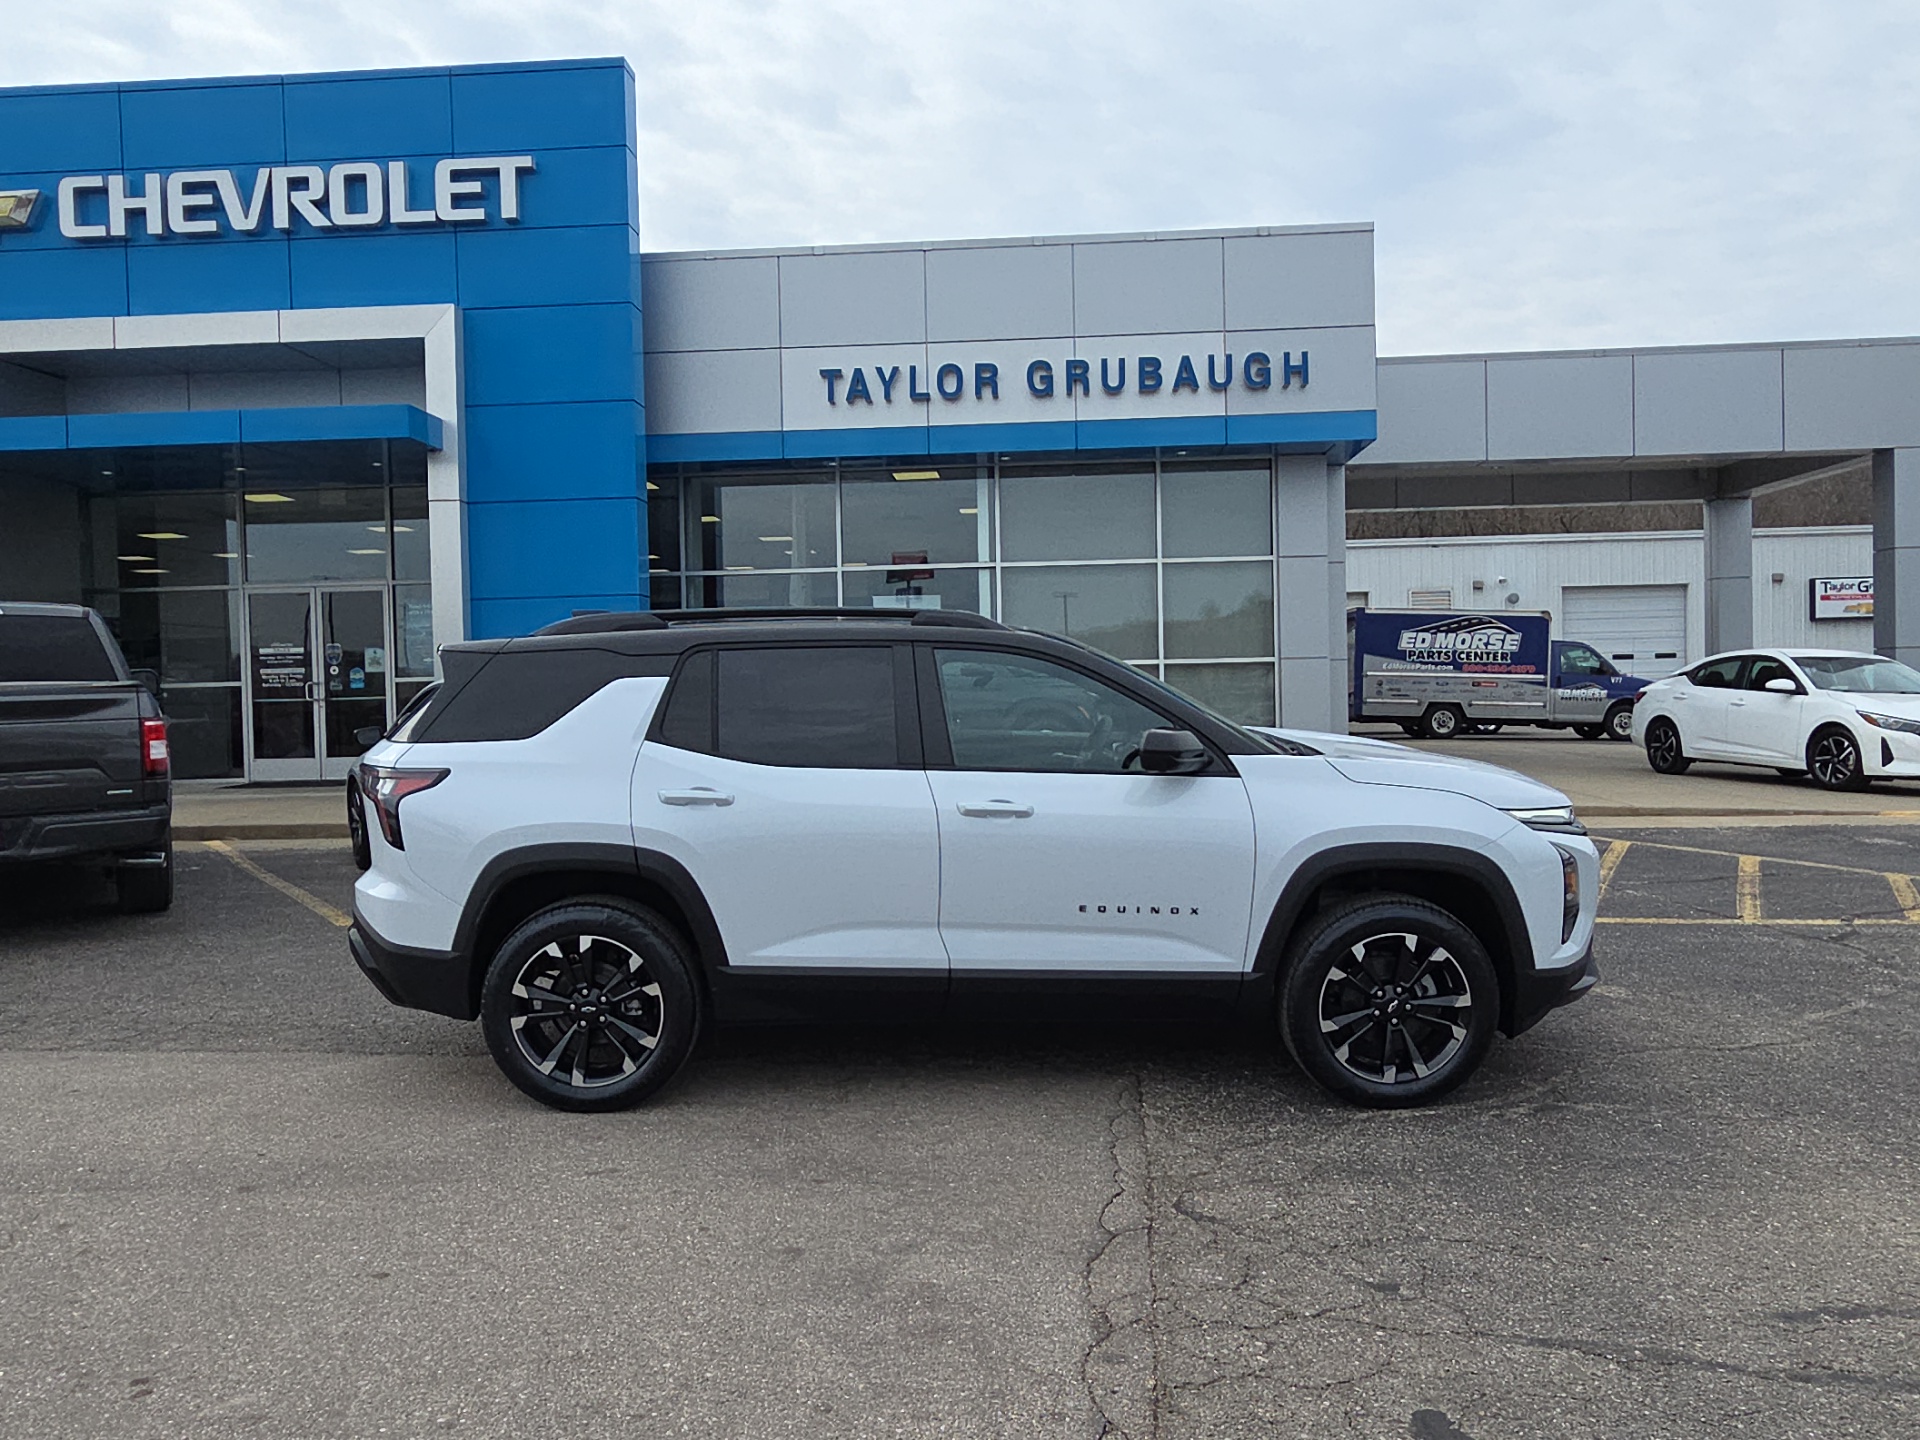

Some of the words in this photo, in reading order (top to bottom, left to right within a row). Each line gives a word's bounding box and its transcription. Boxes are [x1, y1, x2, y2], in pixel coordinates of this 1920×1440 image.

[58, 155, 535, 240] CHEVROLET
[819, 363, 1000, 405] TAYLOR
[1026, 350, 1310, 398] GRUBAUGH
[1820, 581, 1855, 593] Taylor
[1400, 632, 1432, 649] ED
[1434, 632, 1520, 650] MORSE
[1407, 649, 1452, 662] PARTS
[1456, 650, 1511, 663] CENTER
[1078, 904, 1200, 916] EQUINOX
